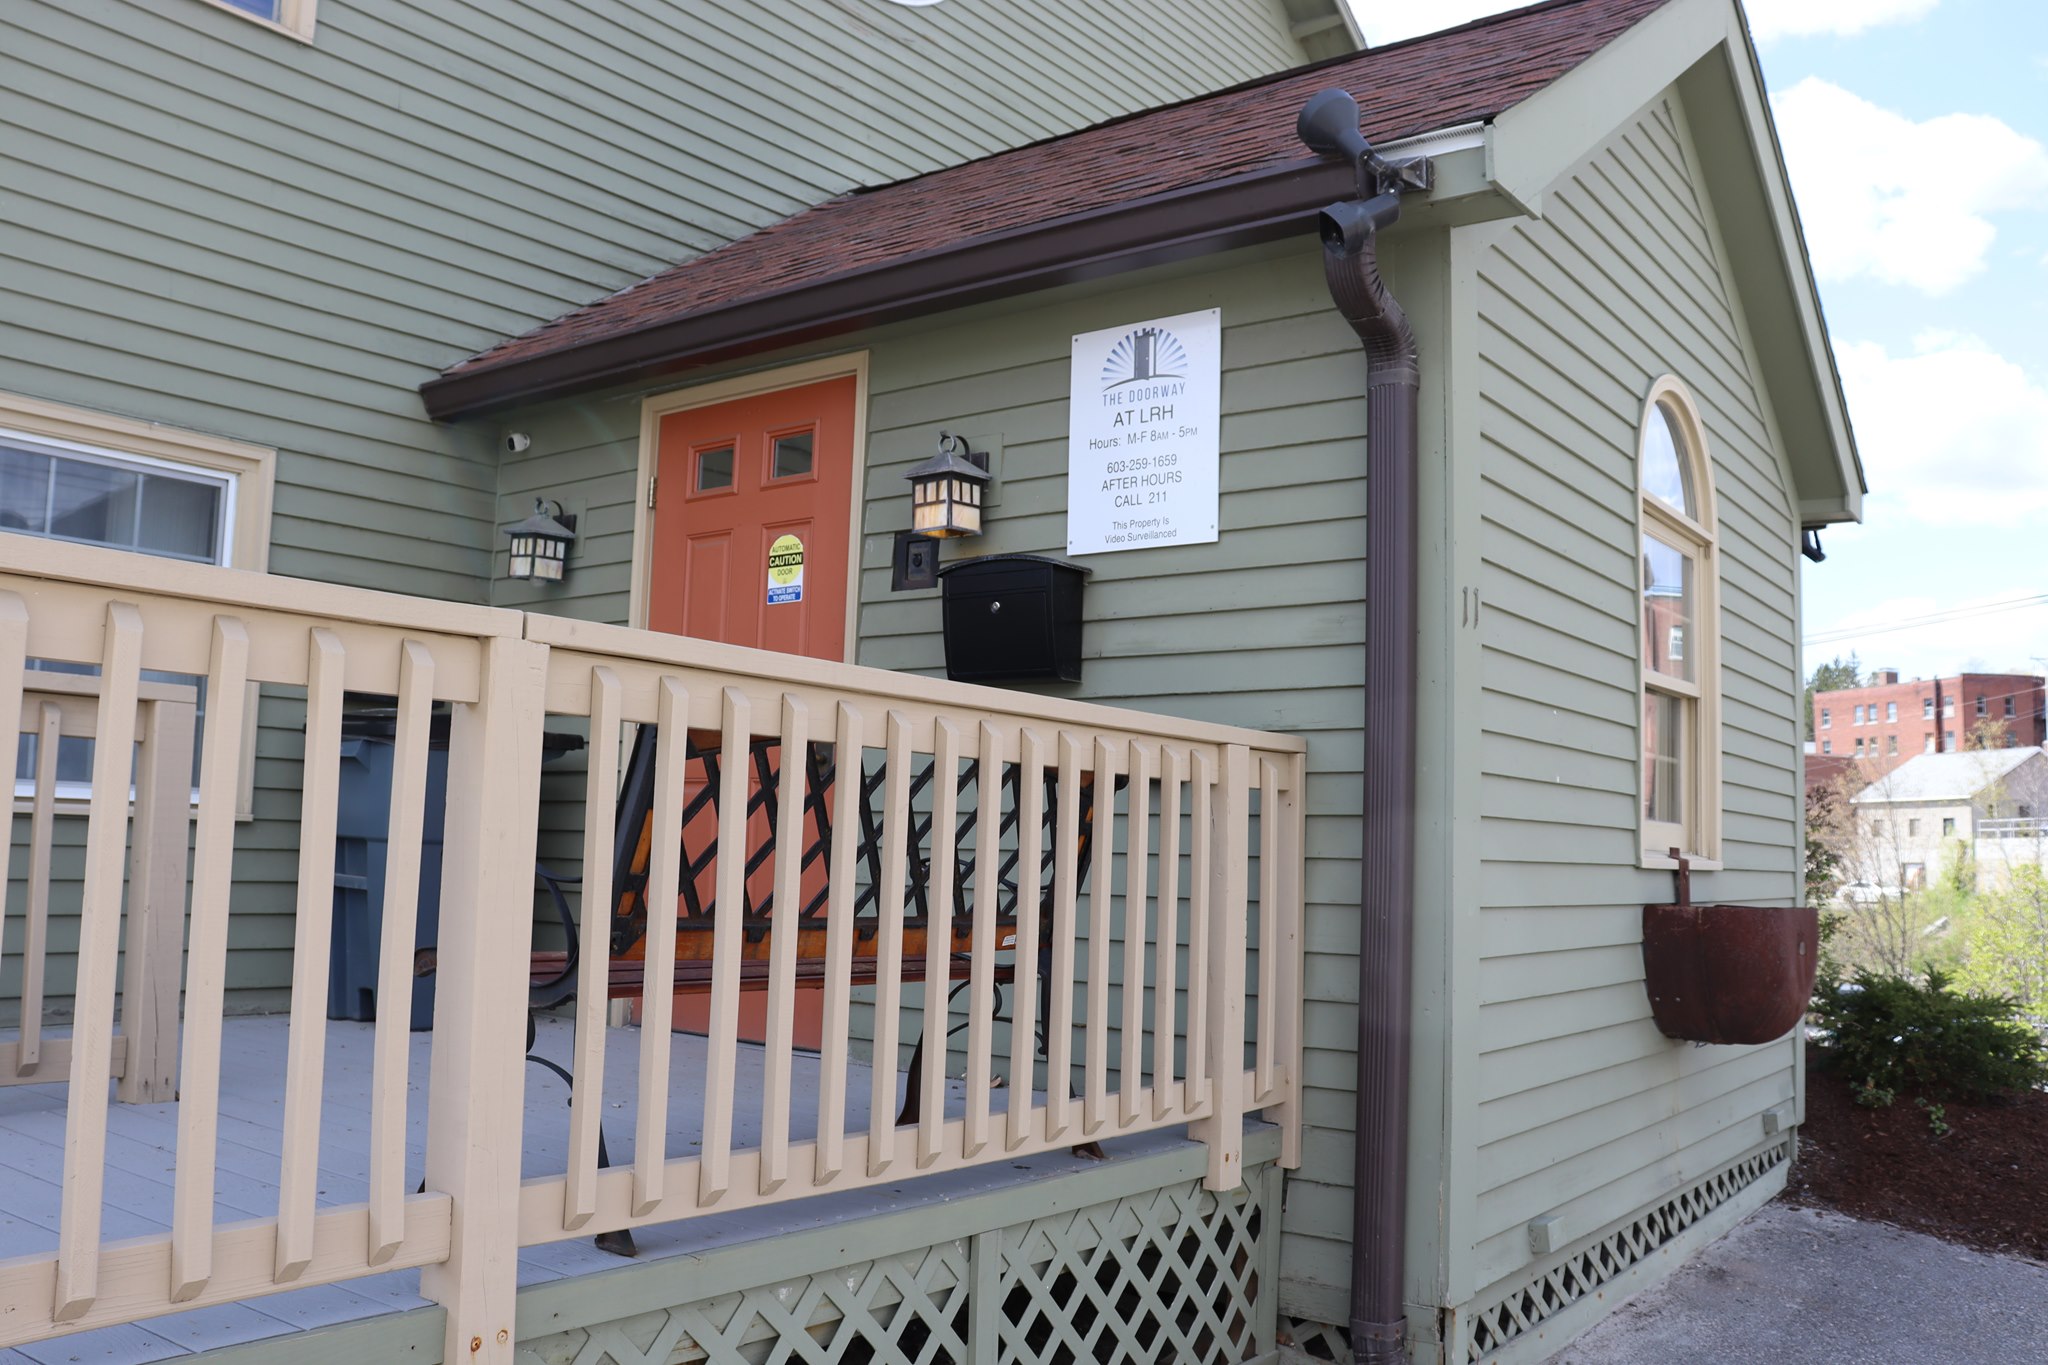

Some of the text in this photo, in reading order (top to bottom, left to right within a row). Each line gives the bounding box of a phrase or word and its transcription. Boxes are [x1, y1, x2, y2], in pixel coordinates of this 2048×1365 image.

[1103, 382, 1186, 406] THE DOORWAY
[1113, 404, 1174, 427] AT LRH
[1089, 437, 1121, 450] Hours:
[1127, 431, 1147, 445] M-F
[1107, 454, 1177, 473] 603-259-1659
[1102, 471, 1182, 492] AFTER HOURS
[1114, 491, 1167, 507] CALL 211
[1113, 520, 1127, 530] This
[1130, 518, 1160, 529] Property
[1105, 528, 1177, 544] Video Surveillanced
[772, 543, 800, 553] AUTOMATIC
[769, 554, 802, 566] CAUTION
[777, 568, 792, 576] DOOR
